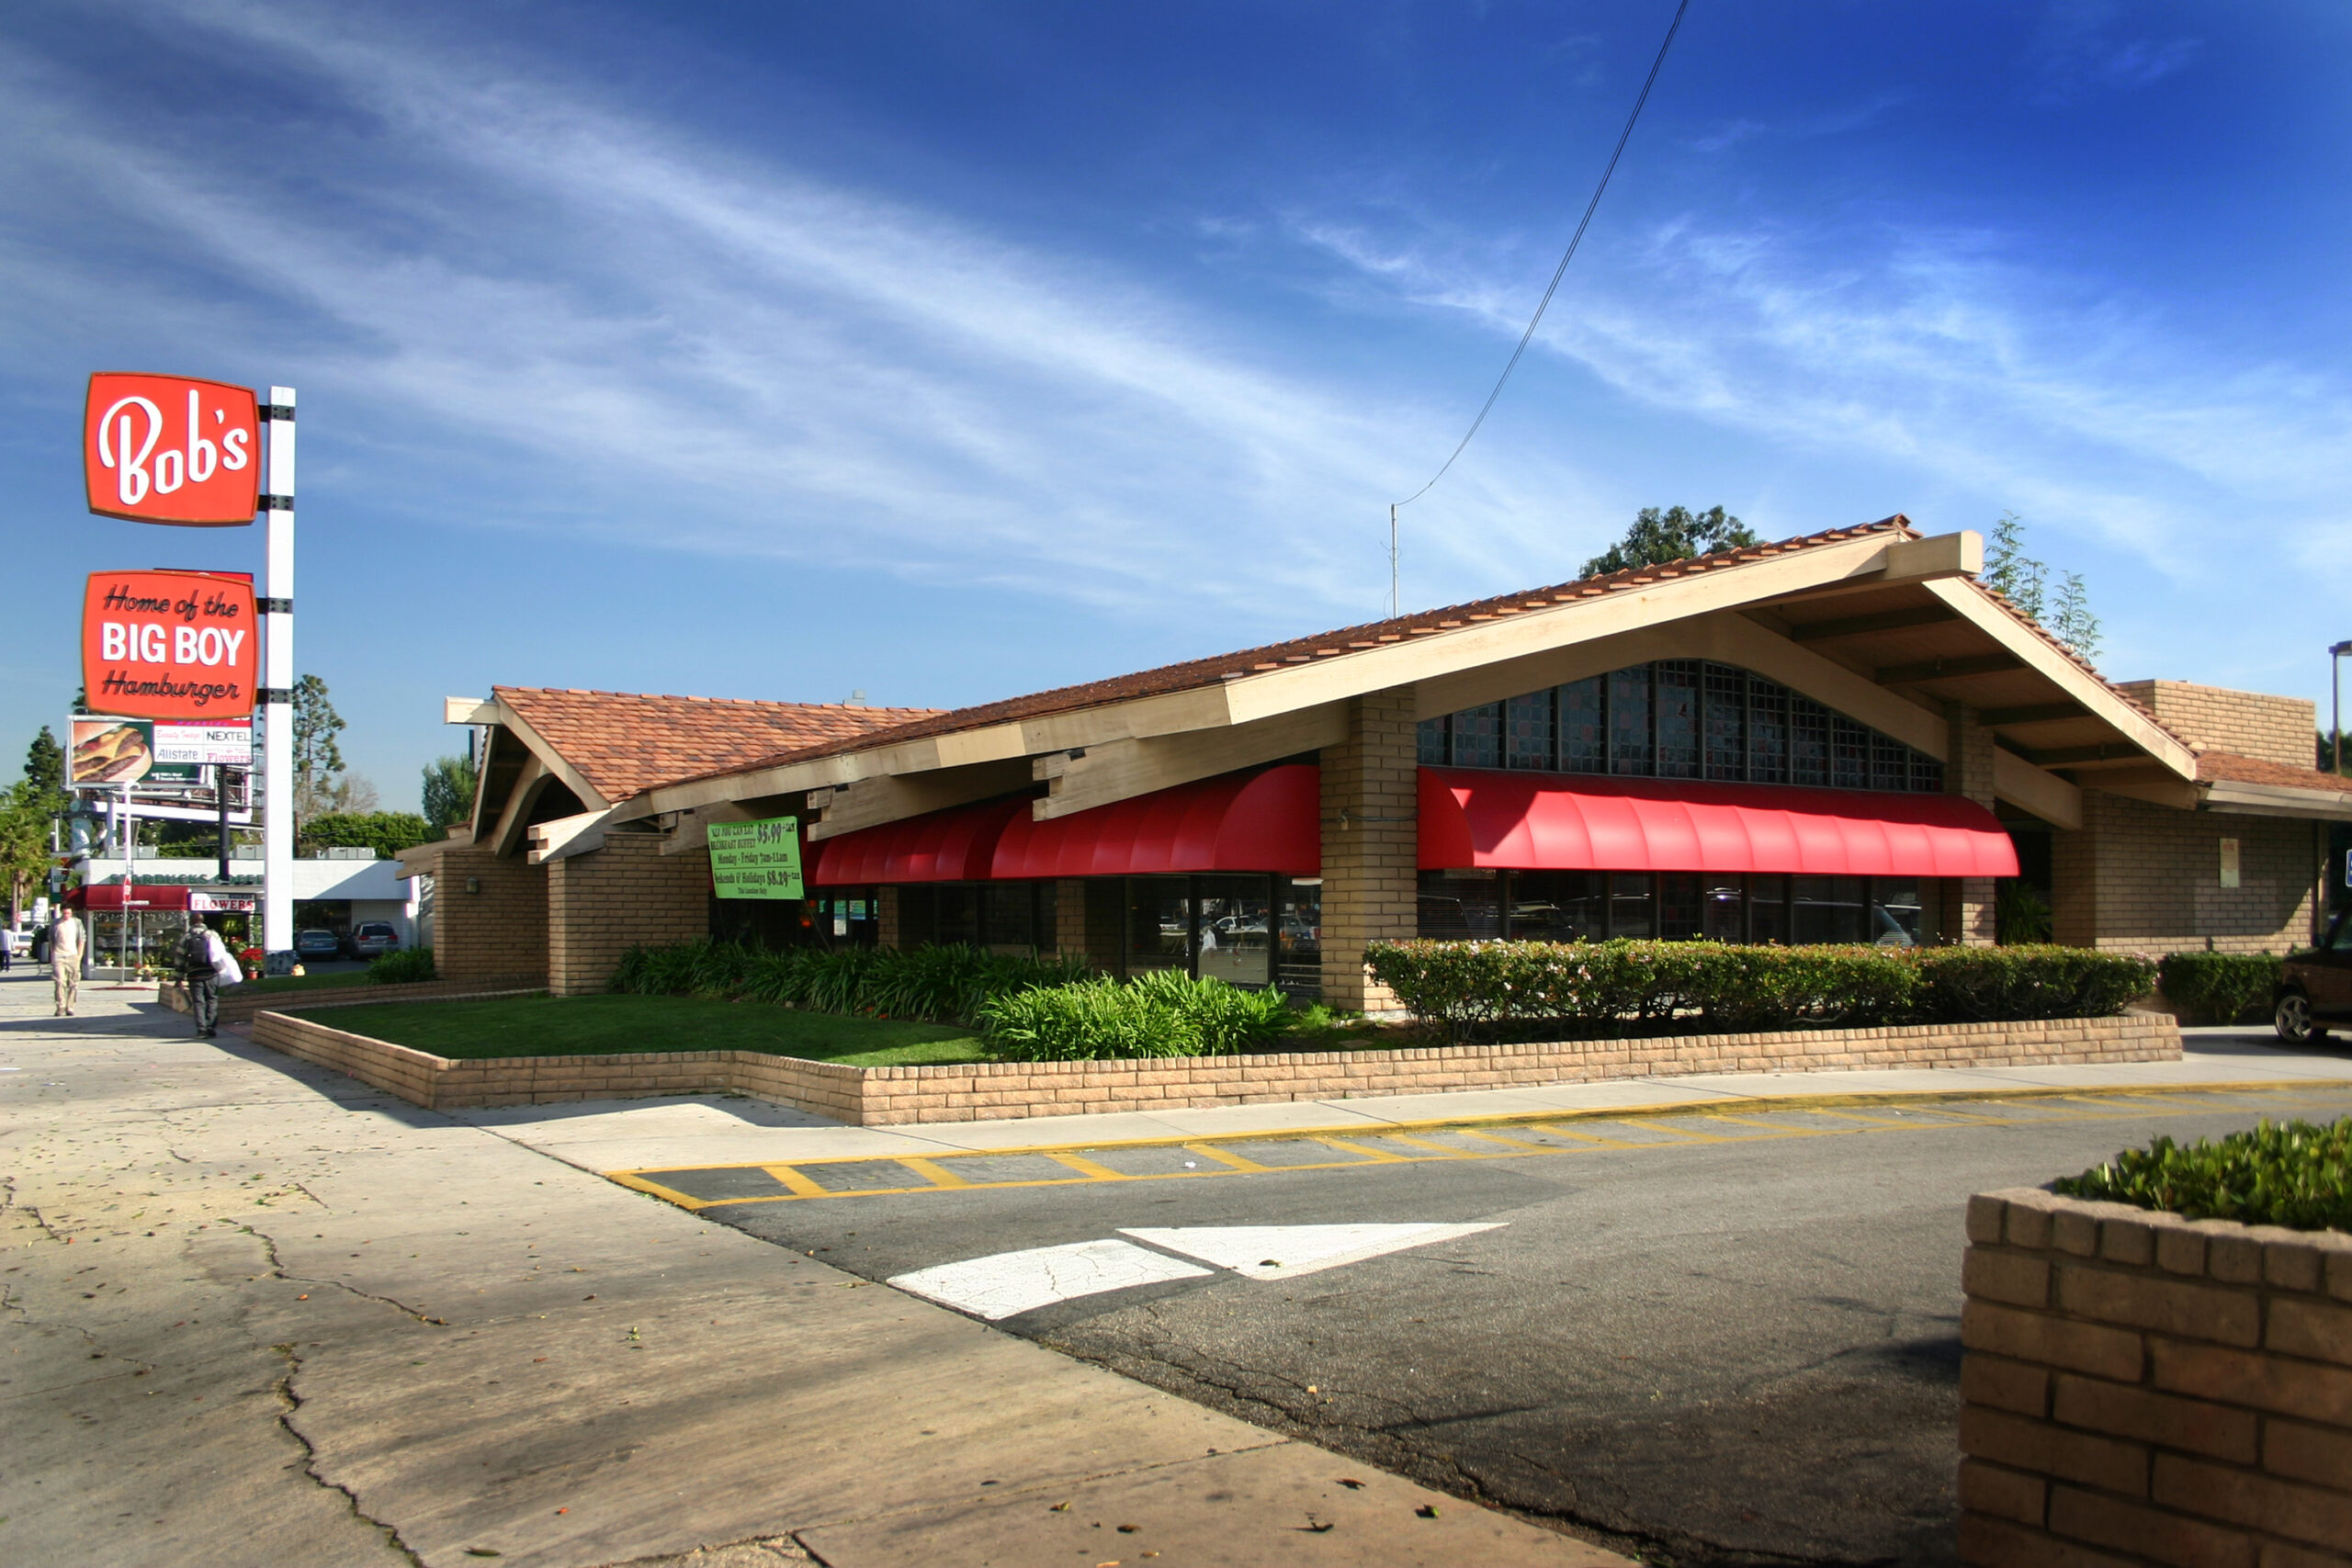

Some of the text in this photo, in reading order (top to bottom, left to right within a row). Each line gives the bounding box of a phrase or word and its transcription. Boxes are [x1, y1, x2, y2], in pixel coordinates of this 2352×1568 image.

[98, 389, 249, 506] Bob's
[103, 583, 240, 621] Home of the
[102, 622, 245, 666] BIG BOY
[101, 670, 241, 706] Hamburger
[207, 730, 251, 741] NEXTEL
[157, 749, 198, 760] Allstate
[207, 752, 252, 762] Flowers
[741, 852, 758, 865] Friday
[715, 873, 735, 883] eekends
[194, 899, 254, 909] FLOWERS
